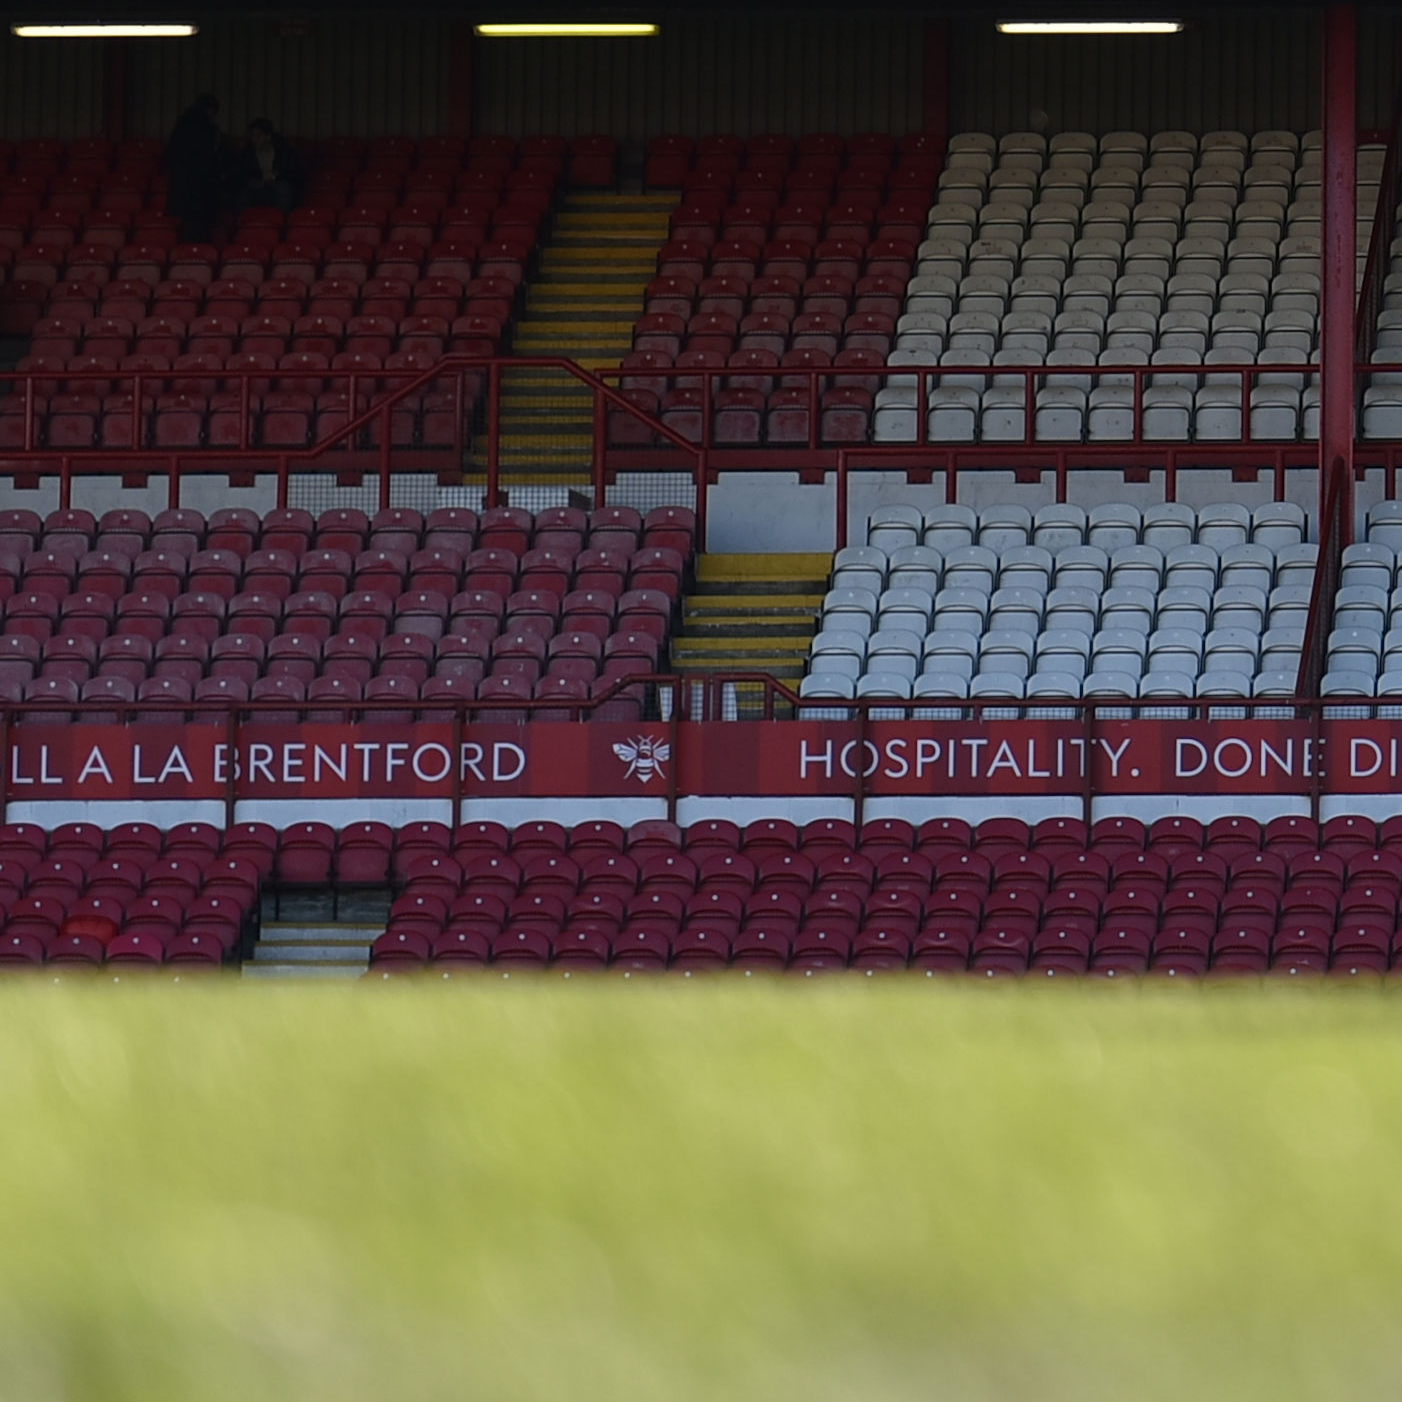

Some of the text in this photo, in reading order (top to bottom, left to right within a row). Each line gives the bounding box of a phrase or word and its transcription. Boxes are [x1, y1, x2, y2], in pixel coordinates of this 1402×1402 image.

[12, 742, 526, 784] LL A LA BRENTFORD
[800, 738, 1141, 779] HOSPITALITY.
[1175, 737, 1326, 778] DONE
